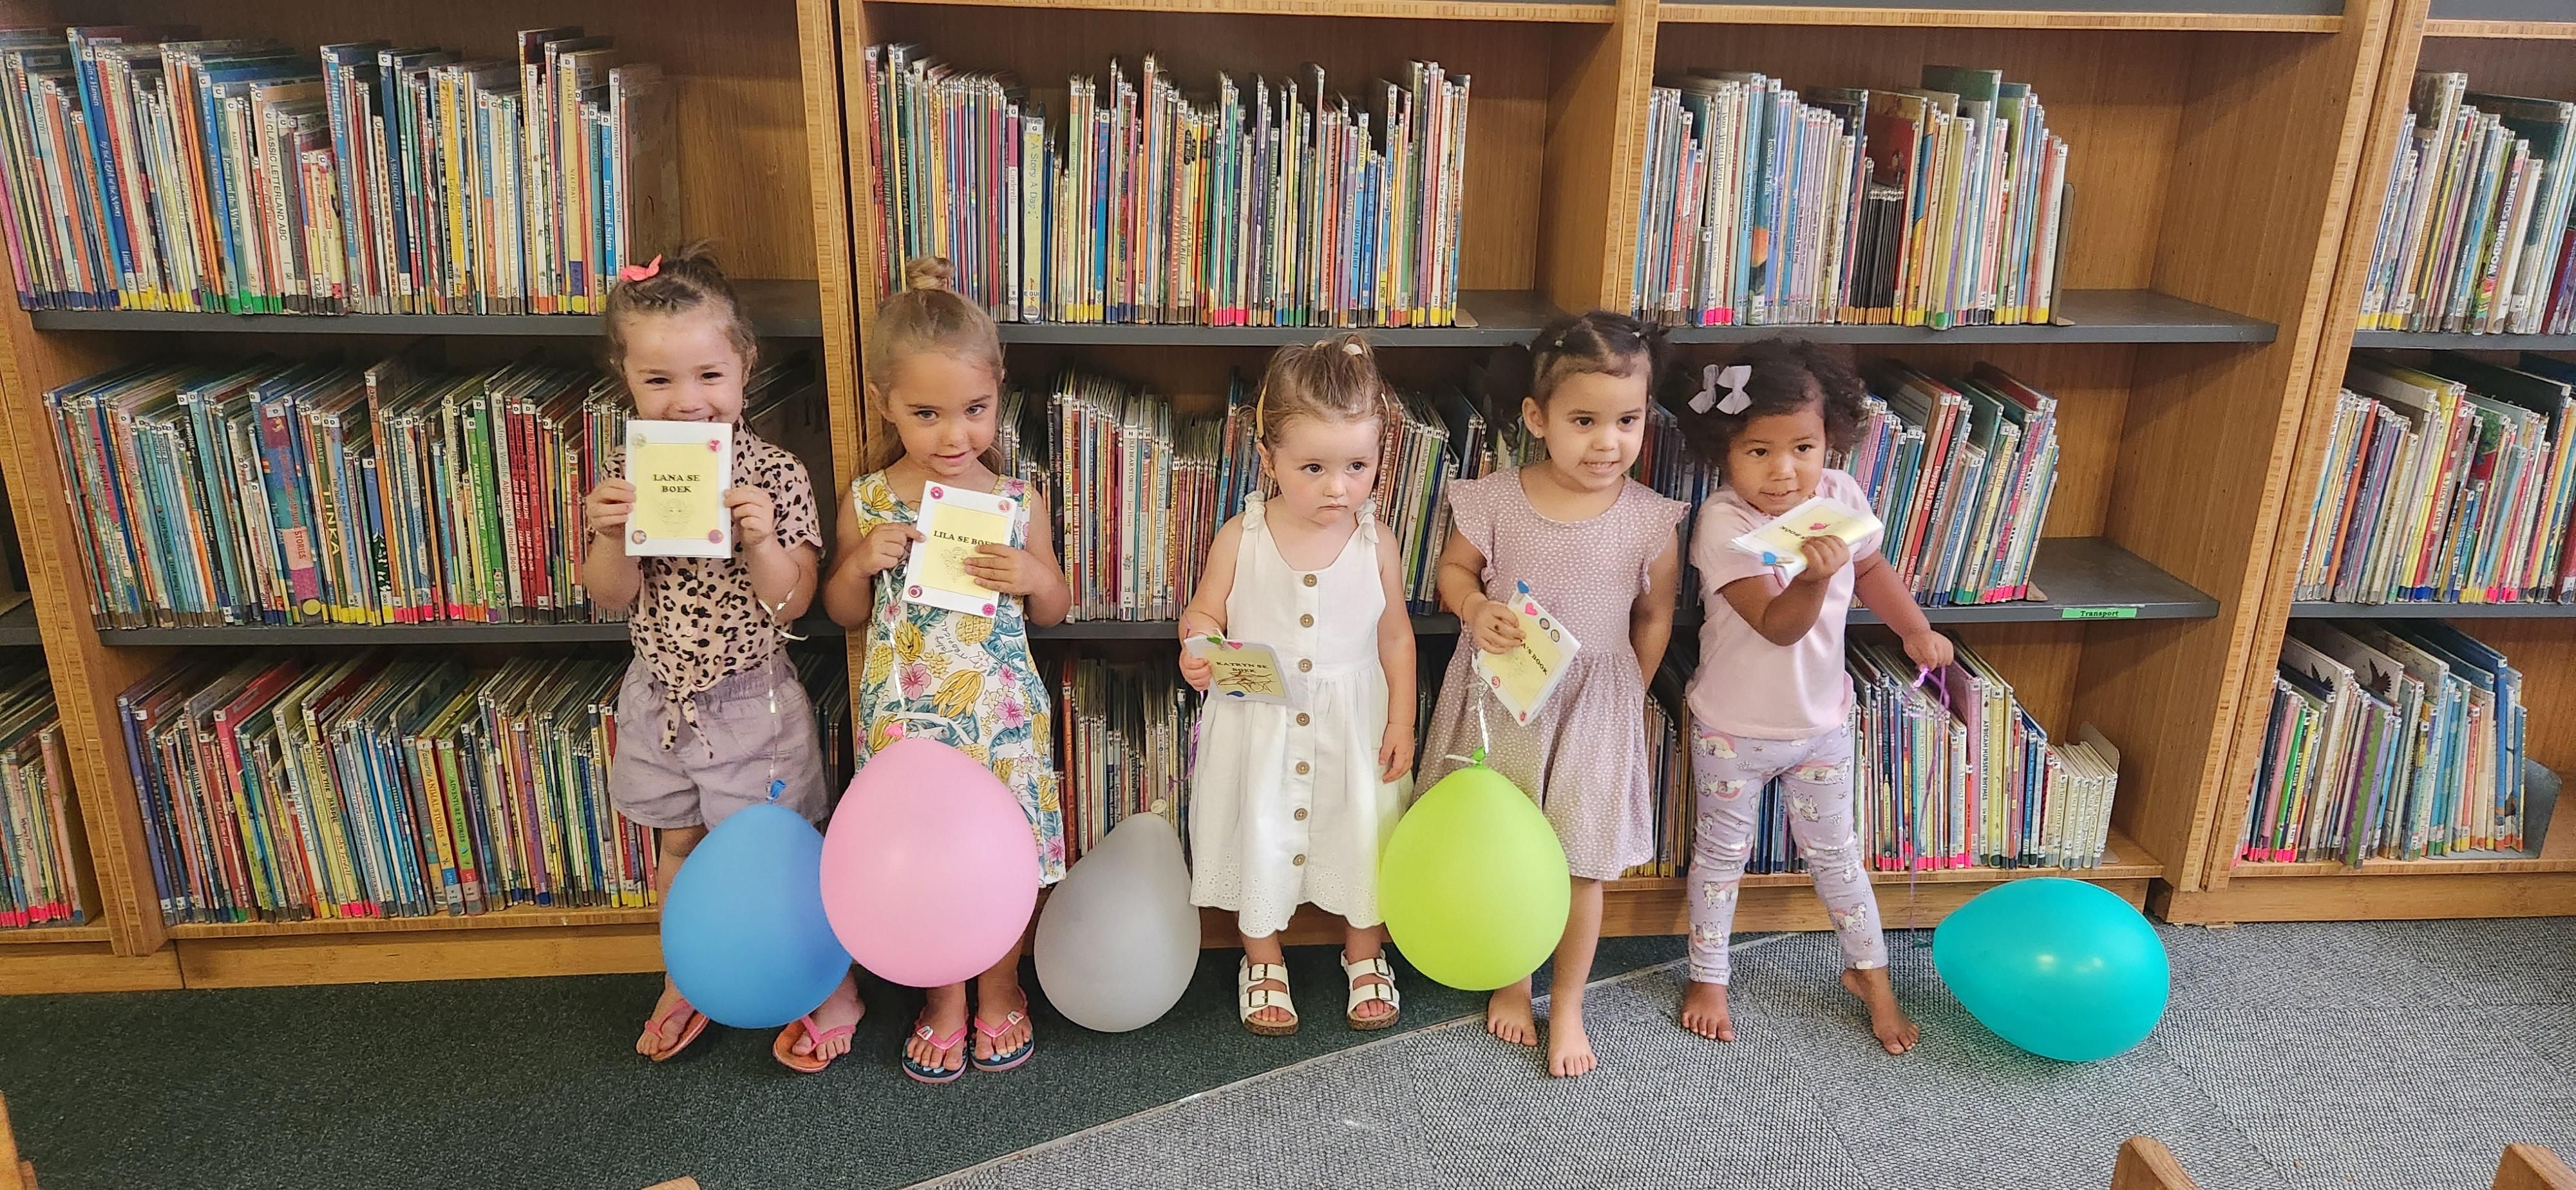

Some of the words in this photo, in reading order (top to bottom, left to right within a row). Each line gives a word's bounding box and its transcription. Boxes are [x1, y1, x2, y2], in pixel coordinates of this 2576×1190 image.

[265, 124, 278, 162] CLASSIC
[1765, 138, 1776, 164] Feathers
[222, 157, 232, 178] Emma
[1028, 154, 1037, 178] Story
[1765, 166, 1773, 178] and
[225, 180, 234, 194] and
[270, 164, 285, 220] LETTERLAND
[393, 185, 401, 211] MIRACLE
[603, 180, 611, 211] Brothers
[1763, 180, 1772, 195] Tails
[110, 194, 121, 218] Moon
[227, 195, 236, 207] the
[1028, 194, 1037, 211] Day
[229, 208, 240, 231] Whale
[278, 222, 287, 240] ABC
[605, 226, 613, 250] Sisters
[2487, 219, 2508, 276] KINGDOM
[497, 424, 506, 449] African
[93, 443, 104, 463] Love
[499, 451, 508, 478] Wildlife
[502, 480, 511, 511] Alphabet
[2439, 484, 2448, 502] PIECE
[321, 484, 340, 555] TINKA
[2432, 510, 2442, 527] CAKE
[294, 531, 306, 559] STORIES
[507, 527, 516, 554] Number
[933, 530, 954, 541] LILA
[958, 535, 970, 543] SE
[2080, 610, 2119, 618] Transport
[1531, 653, 1549, 675] BOOK
[421, 748, 434, 777] Favourite
[287, 766, 298, 792] Hunter's
[313, 738, 327, 774] MANFRED
[321, 777, 331, 792] THE
[326, 797, 338, 823] BADDIE
[293, 793, 301, 806] Best
[426, 777, 439, 806] ANIMAL
[296, 807, 306, 826] Friend
[433, 808, 446, 837] STORIES
[449, 779, 461, 815] ADVENTURE
[456, 818, 466, 842] STORIES
